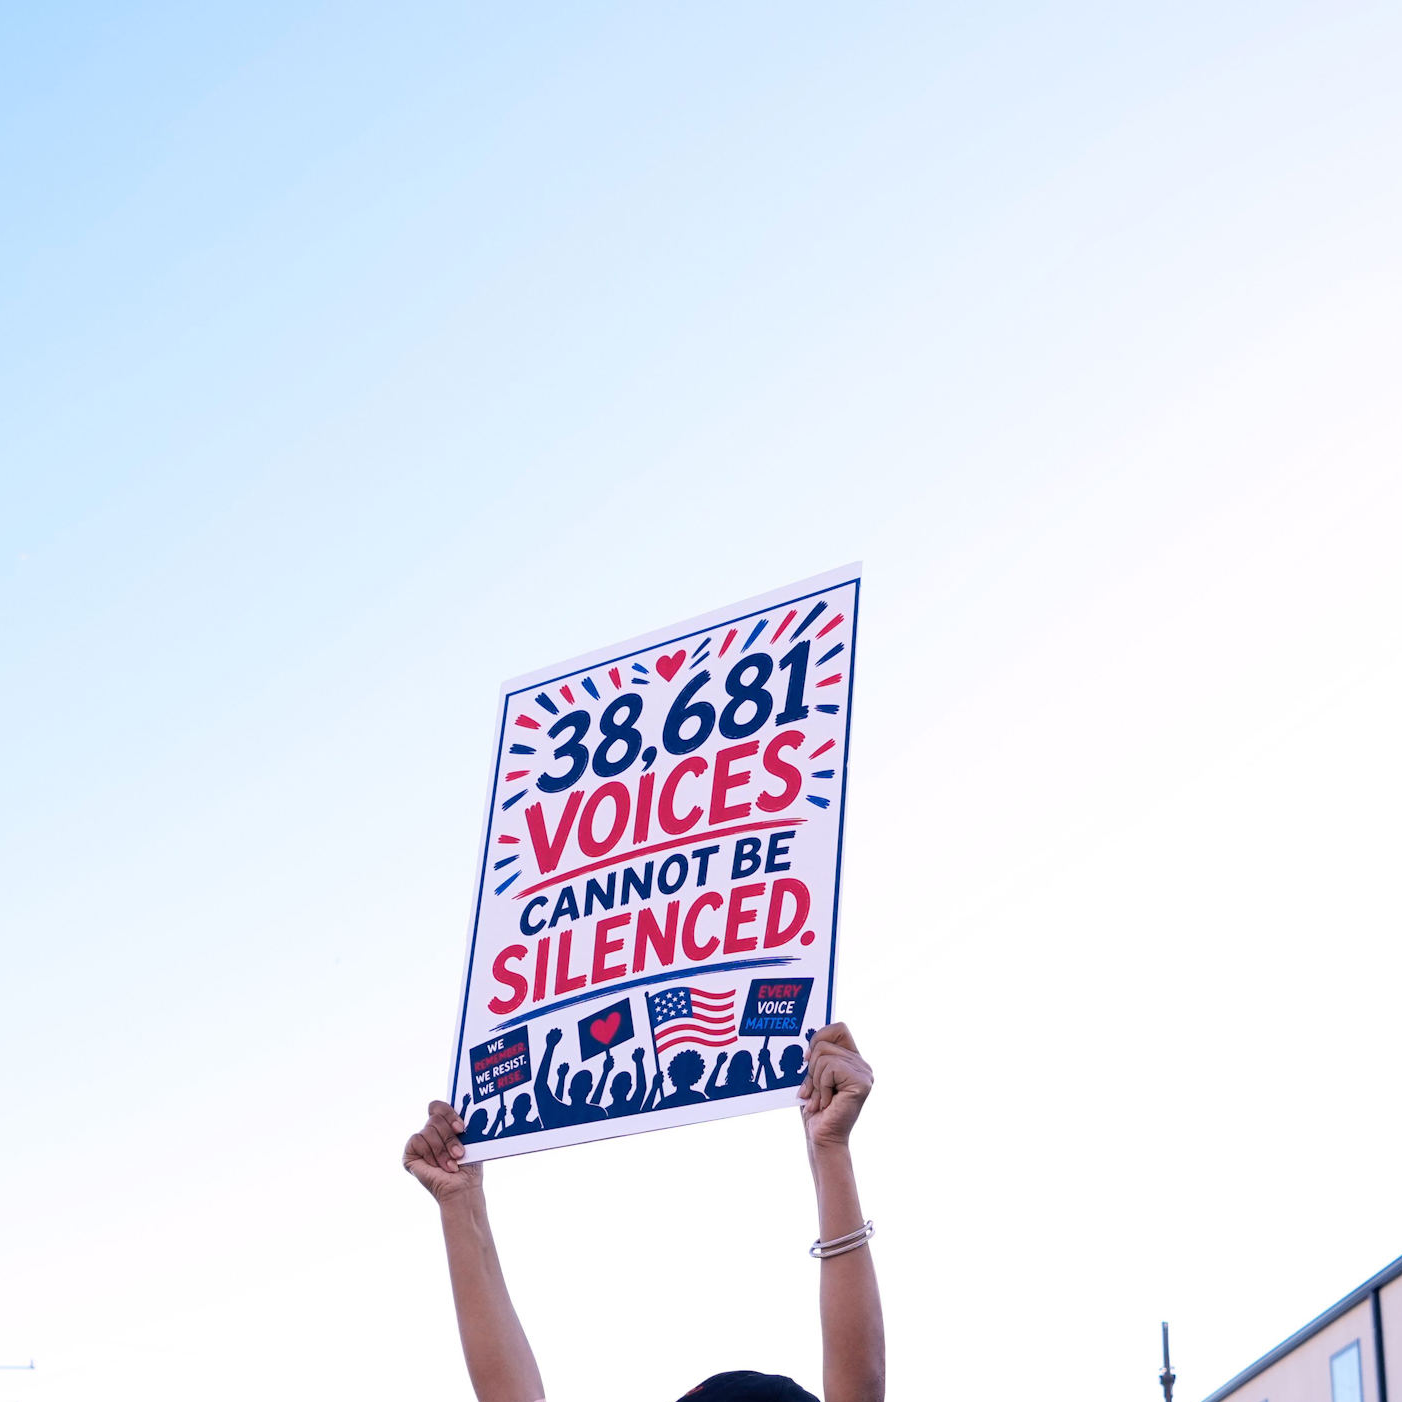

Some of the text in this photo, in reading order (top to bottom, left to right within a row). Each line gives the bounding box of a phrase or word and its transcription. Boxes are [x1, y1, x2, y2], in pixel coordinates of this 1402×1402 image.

[535, 639, 811, 794] 38,681
[525, 729, 806, 875] VOICES
[519, 830, 797, 936] CANNOT BE
[488, 877, 816, 1016] SILENCED.
[758, 984, 802, 999] EVERY
[758, 1001, 795, 1014] VOICE
[745, 1017, 798, 1030] MATTERS.
[487, 1039, 504, 1054] WE
[476, 1055, 527, 1084] WE RESIST.
[479, 1082, 495, 1096] WE
